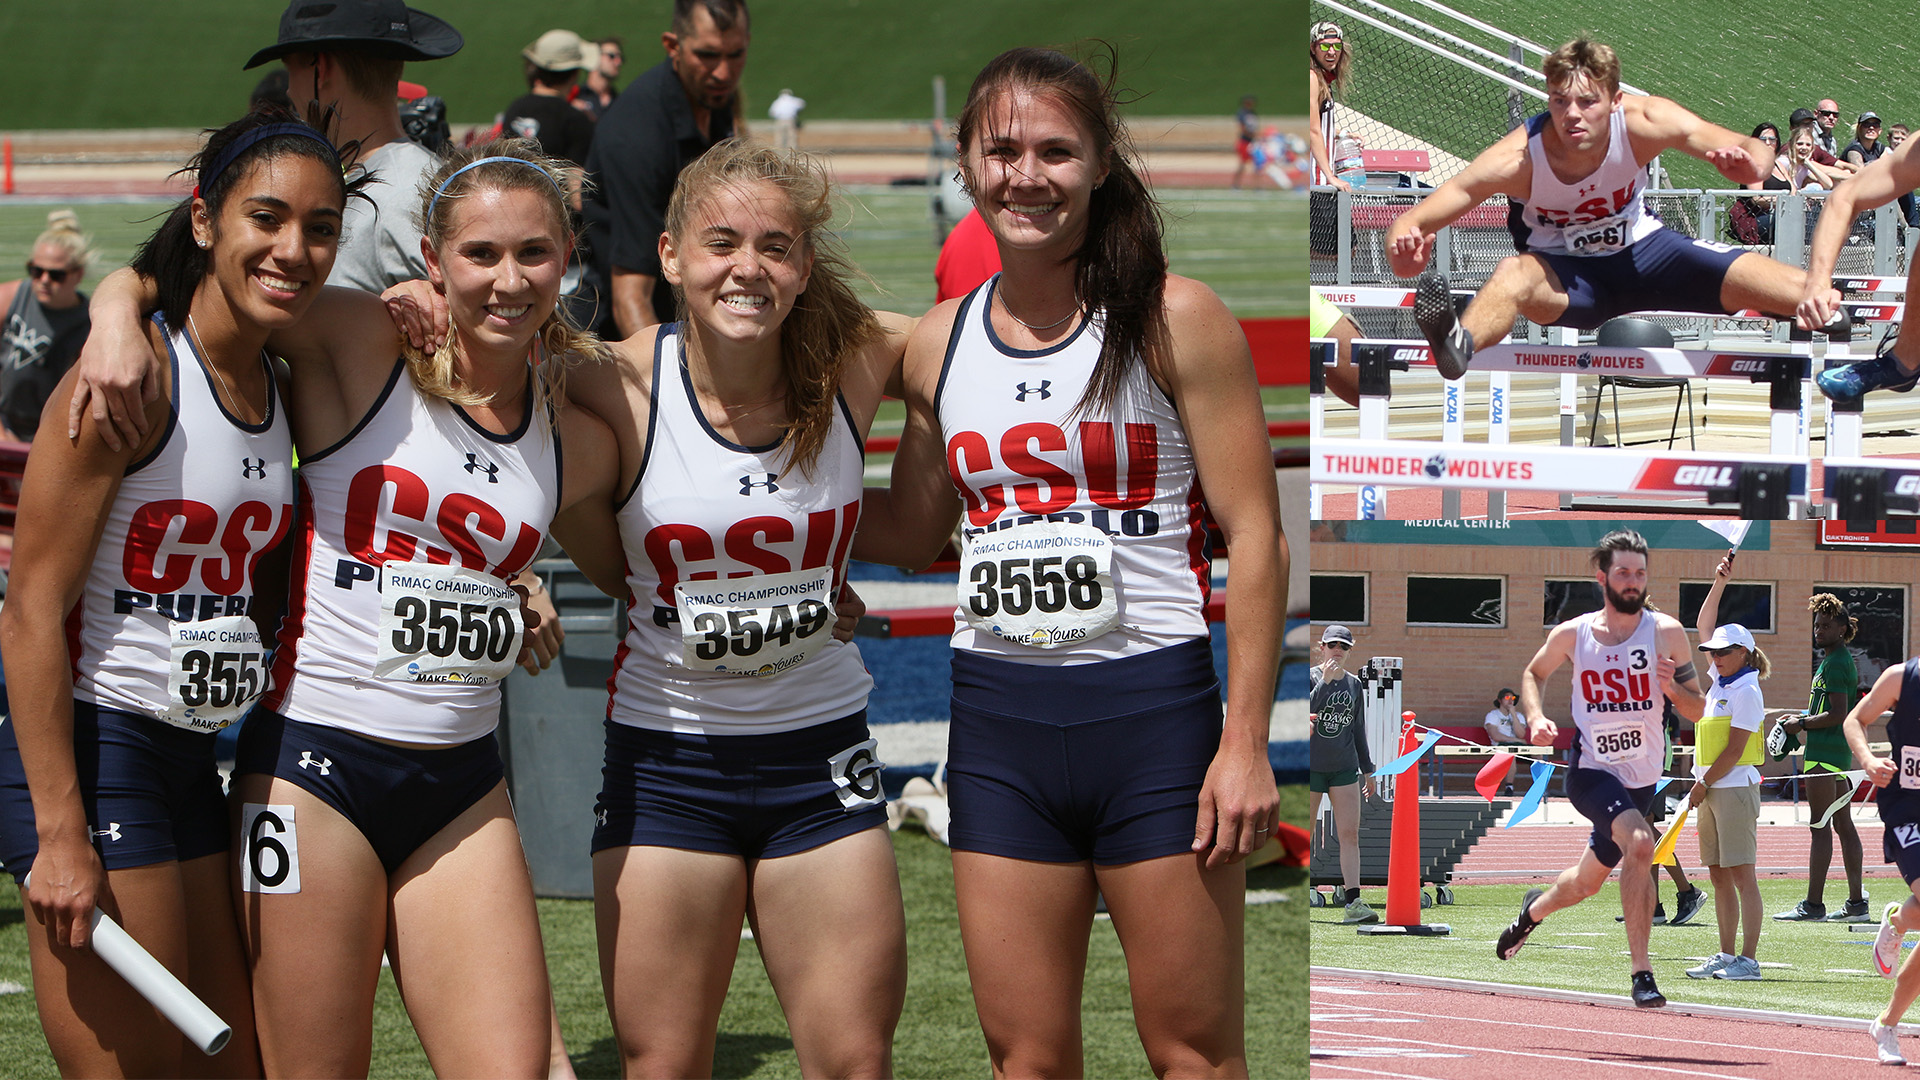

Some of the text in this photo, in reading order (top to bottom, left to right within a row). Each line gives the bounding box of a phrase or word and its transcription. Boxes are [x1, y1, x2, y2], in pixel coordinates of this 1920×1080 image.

[1847, 281, 1868, 289] GILL
[1854, 308, 1881, 317] GILL
[1394, 349, 1429, 361] GILL
[1514, 352, 1645, 369] THUNDER WOLVES
[1731, 360, 1766, 372] GILL
[1447, 386, 1458, 423] NCAA
[1492, 387, 1503, 424] NCAA
[947, 422, 1158, 527] CSU
[1323, 454, 1533, 480] THUNDER WOLVES
[1673, 465, 1733, 486] GILL
[1362, 485, 1375, 520] CAA
[1404, 519, 1511, 529] MEDICAL CENTER
[972, 536, 1105, 556] RMAC CHAMPIONSHIP
[391, 575, 432, 590] RMAC
[435, 579, 515, 600] CHAMPIONSHIP
[685, 579, 825, 606] RMAC CHAMPIONSHIP
[969, 555, 1102, 617] 3558
[180, 630, 217, 642] RMAC
[392, 596, 515, 662] 3550
[694, 598, 829, 660] 3549
[1004, 633, 1031, 643] MAKE
[1049, 626, 1086, 643] YOURS
[773, 652, 805, 674] YOURS
[1630, 649, 1648, 670] 3
[180, 650, 270, 708] 3551
[416, 674, 447, 682] MAKE
[1581, 668, 1650, 703] CSU
[1587, 700, 1653, 713] PUEBLO
[192, 718, 218, 730] MAKE
[1596, 729, 1642, 754] 3568
[844, 748, 880, 800] 6
[249, 810, 290, 888] 6
